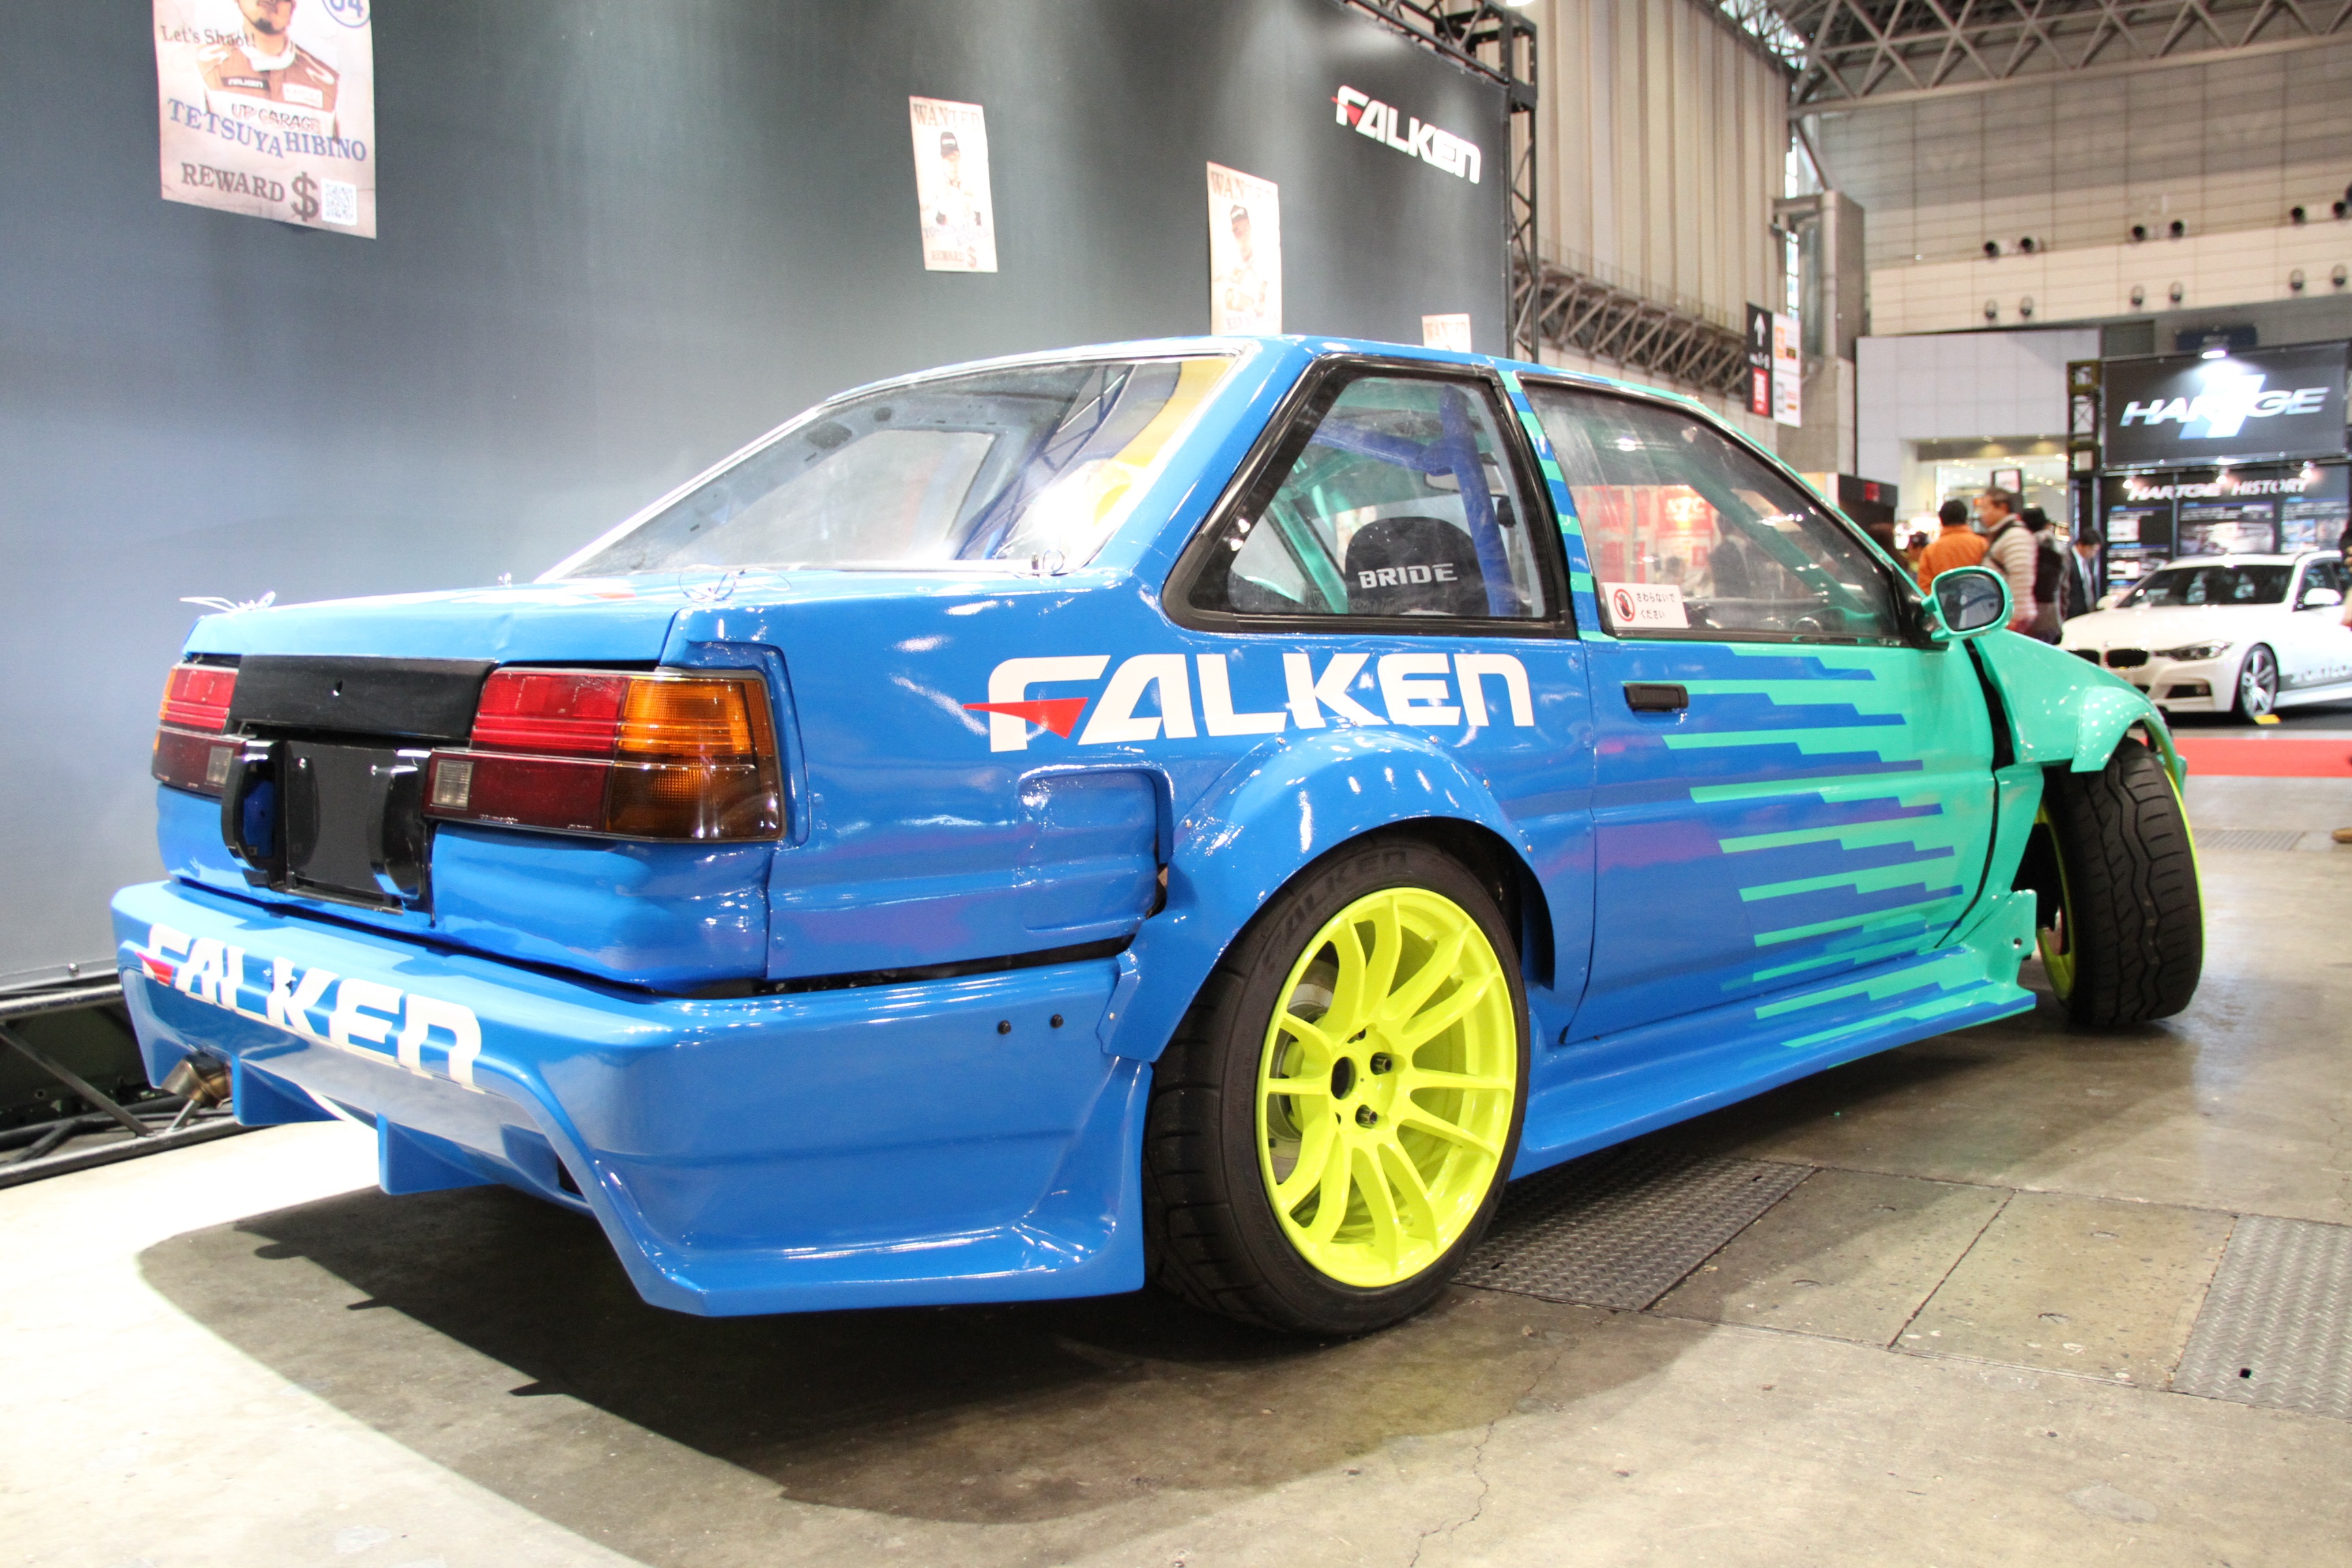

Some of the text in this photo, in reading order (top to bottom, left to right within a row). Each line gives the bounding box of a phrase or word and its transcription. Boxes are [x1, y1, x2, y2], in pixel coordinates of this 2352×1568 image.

[161, 25, 200, 43] Let's
[167, 98, 367, 162] TETSUYA HIBINO
[1332, 85, 1481, 184] FALKEN
[181, 163, 319, 222] REWARD $
[2120, 387, 2330, 427] HARGE
[2126, 478, 2310, 502] HARTGE HISTORY
[1358, 563, 1458, 589] BRIDE
[1636, 593, 1675, 602] さわらないで
[1641, 610, 1665, 619] ください
[966, 653, 1534, 752] FALKEN
[135, 923, 485, 1094] FALKEN
